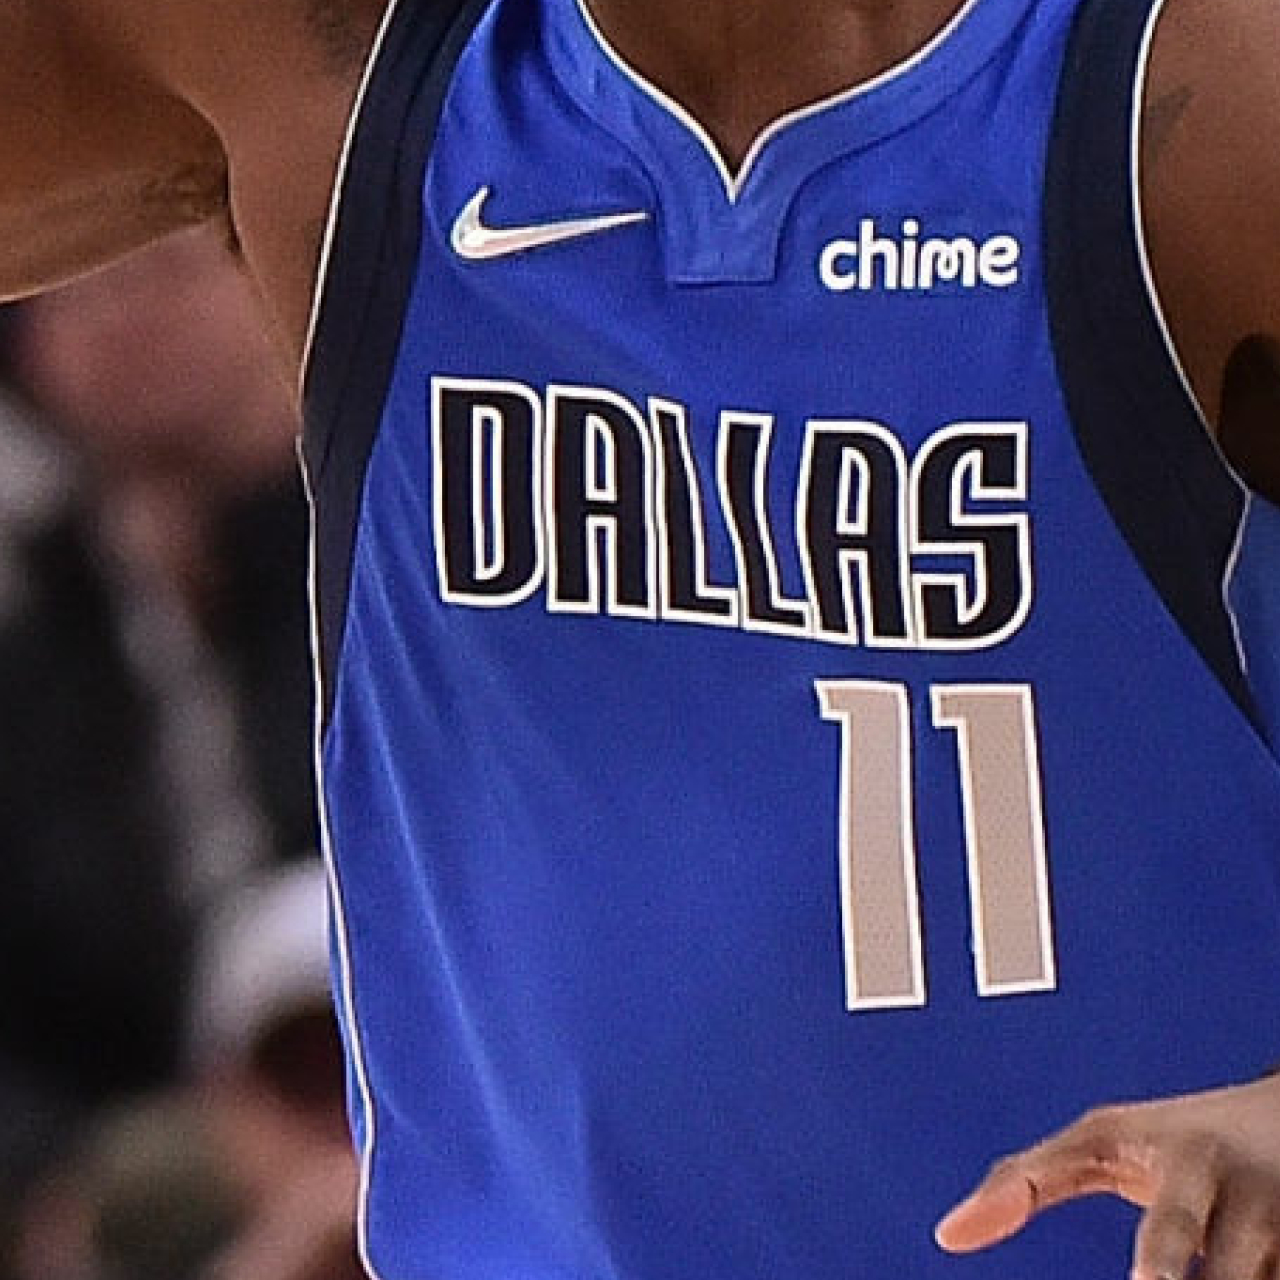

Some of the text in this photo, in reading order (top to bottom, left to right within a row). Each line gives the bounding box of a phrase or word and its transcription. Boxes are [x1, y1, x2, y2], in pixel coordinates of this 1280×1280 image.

[818, 219, 1020, 291] chime
[430, 375, 1033, 652] DALLAS
[813, 679, 1058, 1012] 11
